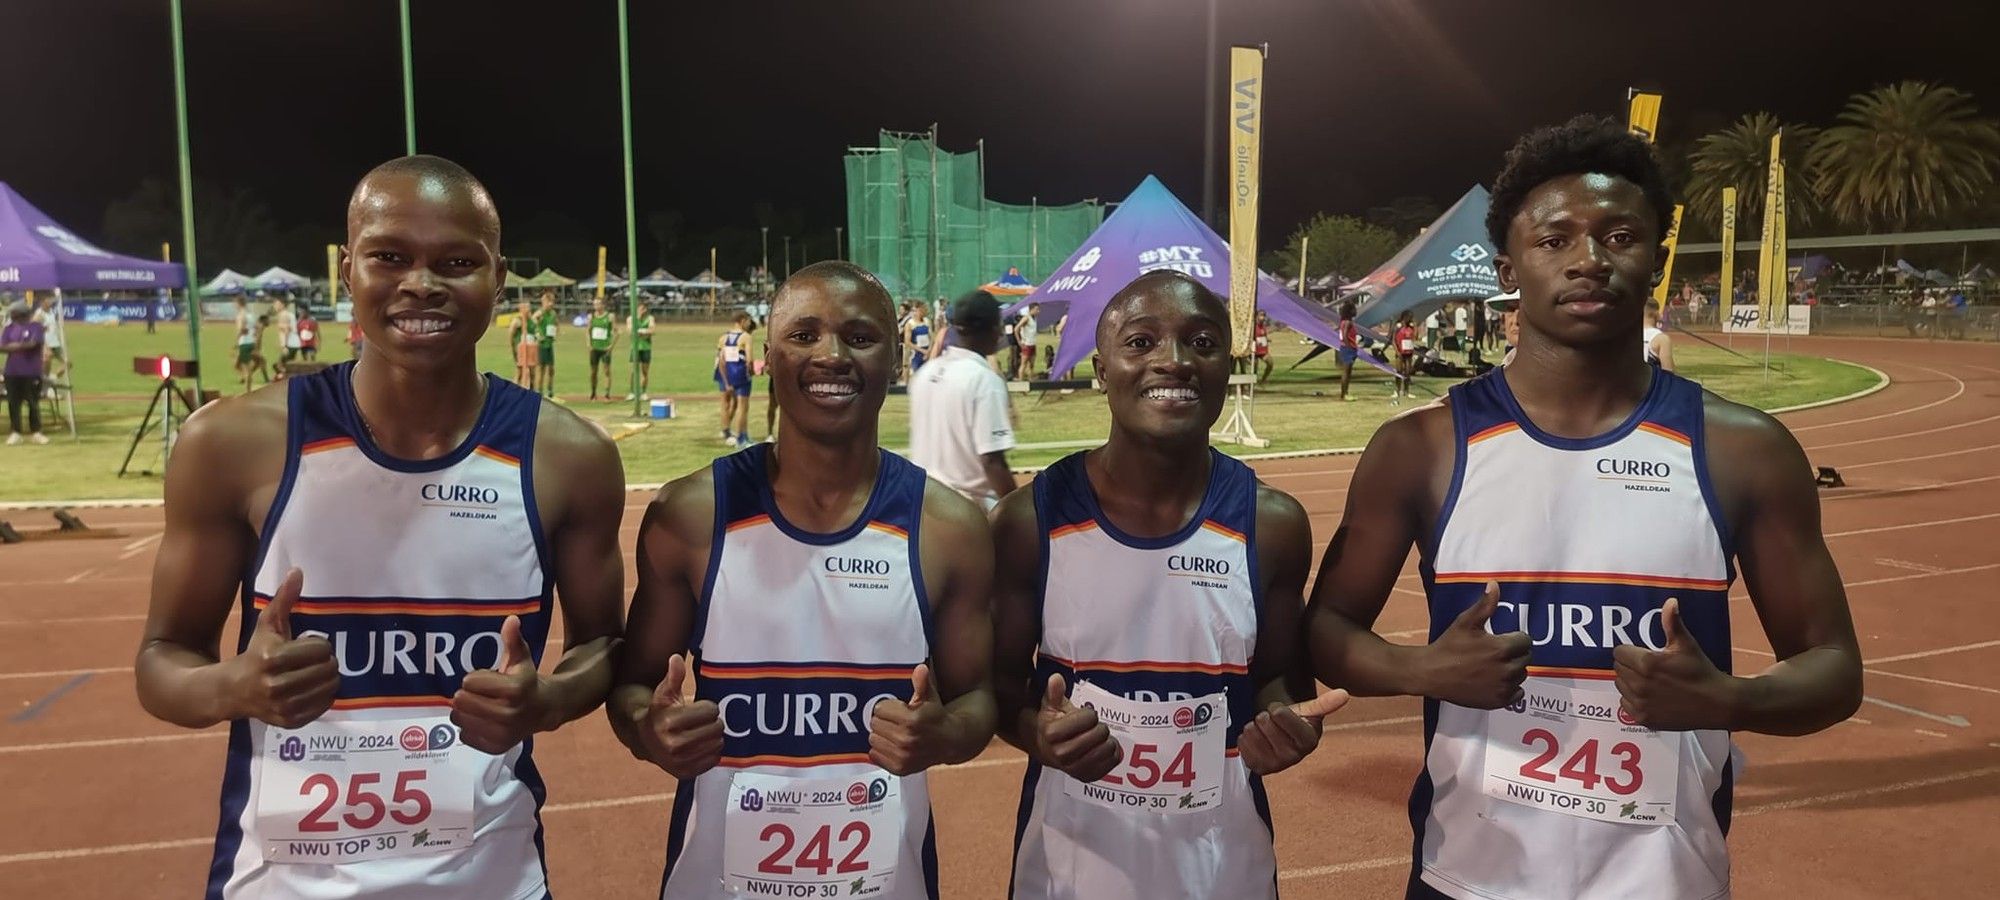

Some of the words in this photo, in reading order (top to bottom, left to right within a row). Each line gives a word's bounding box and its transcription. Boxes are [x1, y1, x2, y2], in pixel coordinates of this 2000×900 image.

[1138, 246, 1202, 263] #MY
[1597, 458, 1671, 478] CURRO
[421, 483, 499, 504] CURRO
[1625, 484, 1671, 493] HAZELDEAN
[450, 511, 497, 520] HAZELDEAN
[825, 556, 890, 575] CURRO
[1167, 555, 1230, 575] CURRO
[849, 582, 889, 590] HAZELDEAN
[1191, 580, 1229, 589] HAZELDEAN
[297, 630, 504, 677] URRO
[1578, 704, 1612, 718] 2024
[1141, 715, 1169, 726] 2024
[359, 735, 394, 748] 2024
[1519, 728, 1643, 795] 243
[298, 770, 432, 832] 255
[812, 791, 842, 803] 2024
[1084, 785, 1115, 802] NWU
[1119, 793, 1147, 807] TOP
[1150, 797, 1168, 808] 30
[1507, 783, 1544, 803] NWU
[1549, 793, 1582, 810] TOP
[1586, 801, 1606, 814] 30
[290, 842, 330, 856] NWU
[335, 840, 370, 855] TOP
[376, 836, 397, 850] 30
[423, 839, 453, 847] ACNW
[757, 821, 871, 875] 242
[747, 881, 782, 896] NWU
[787, 884, 816, 897] TOP
[820, 884, 838, 897] 30
[858, 886, 881, 896] ACNW
